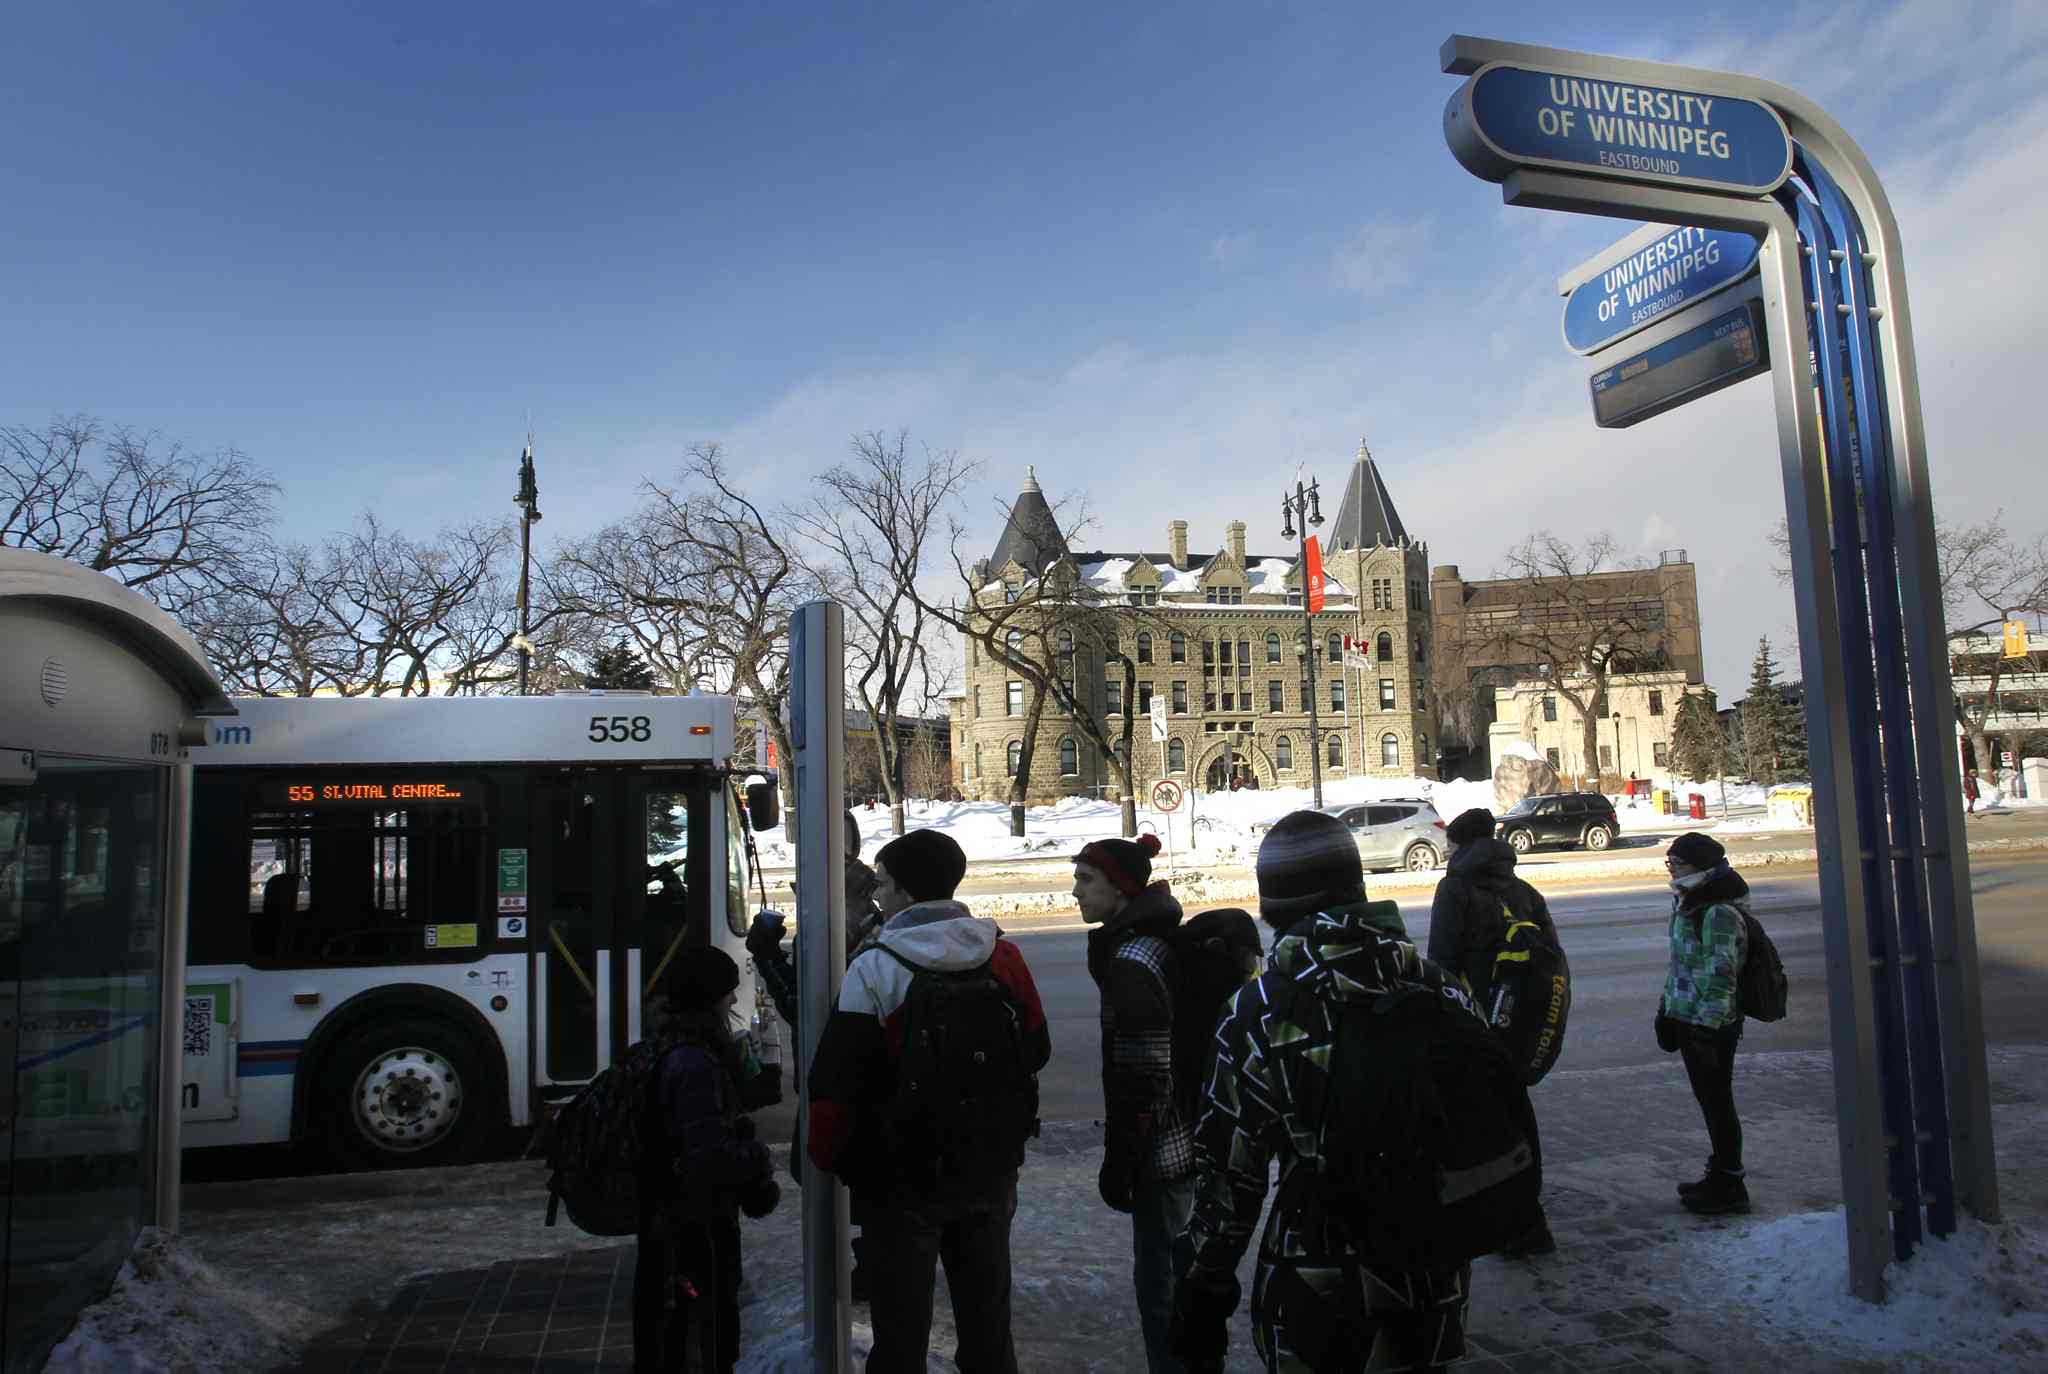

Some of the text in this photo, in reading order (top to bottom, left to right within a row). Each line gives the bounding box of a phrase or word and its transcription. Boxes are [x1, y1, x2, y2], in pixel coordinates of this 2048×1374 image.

[1550, 78, 1713, 125] UNIVERSITY
[1538, 108, 1730, 159] OF WINNIPEG
[1600, 150, 1680, 175] EASTBOUND
[1598, 240, 1721, 322] OF WINNIPEG
[1632, 289, 1684, 325] EASTBOUND
[216, 726, 251, 745] m
[588, 716, 652, 743] 558
[288, 786, 315, 801] 55
[1547, 975, 1565, 1023] team
